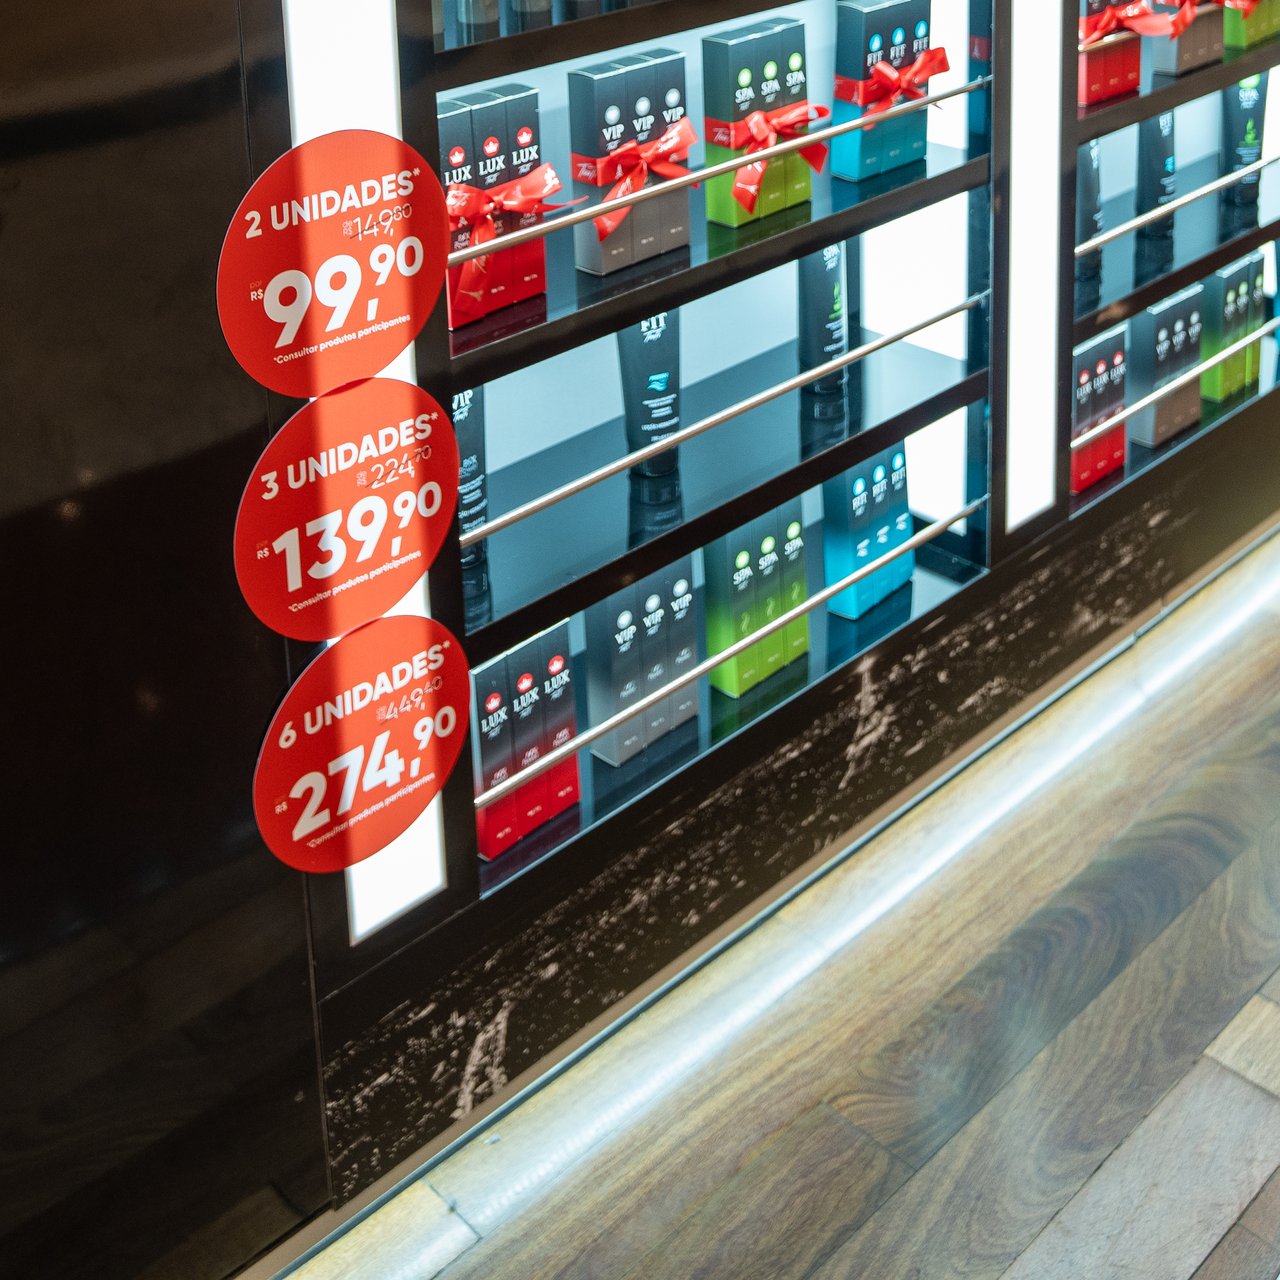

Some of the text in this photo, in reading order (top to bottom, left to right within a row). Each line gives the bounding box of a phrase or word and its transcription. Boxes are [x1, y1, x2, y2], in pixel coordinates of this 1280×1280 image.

[760, 79, 781, 96] SPA
[786, 70, 806, 87] SPA
[735, 86, 755, 103] SPA
[632, 114, 655, 132] VIP
[662, 106, 685, 123] VIP
[602, 123, 625, 141] VIP
[478, 154, 506, 176] LUX
[511, 144, 539, 166] LUX
[444, 164, 472, 187] LUX
[244, 210, 263, 240] 2
[263, 236, 424, 349] 99,90
[319, 331, 357, 352] produtos
[357, 313, 411, 340] participantes
[260, 470, 280, 501] 3
[271, 481, 443, 593] 139,90
[784, 536, 804, 555] SPA
[759, 551, 779, 571] SPA
[332, 573, 369, 596] produtos
[369, 550, 422, 580] participantes
[733, 566, 754, 586] SPA
[671, 593, 692, 612] VIP
[643, 608, 664, 629] VIP
[615, 625, 636, 645] VIP
[544, 668, 570, 696] LUX
[513, 686, 539, 714] LUX
[481, 706, 508, 734] LUX
[278, 720, 298, 749] 6
[288, 706, 457, 842] 274,90
